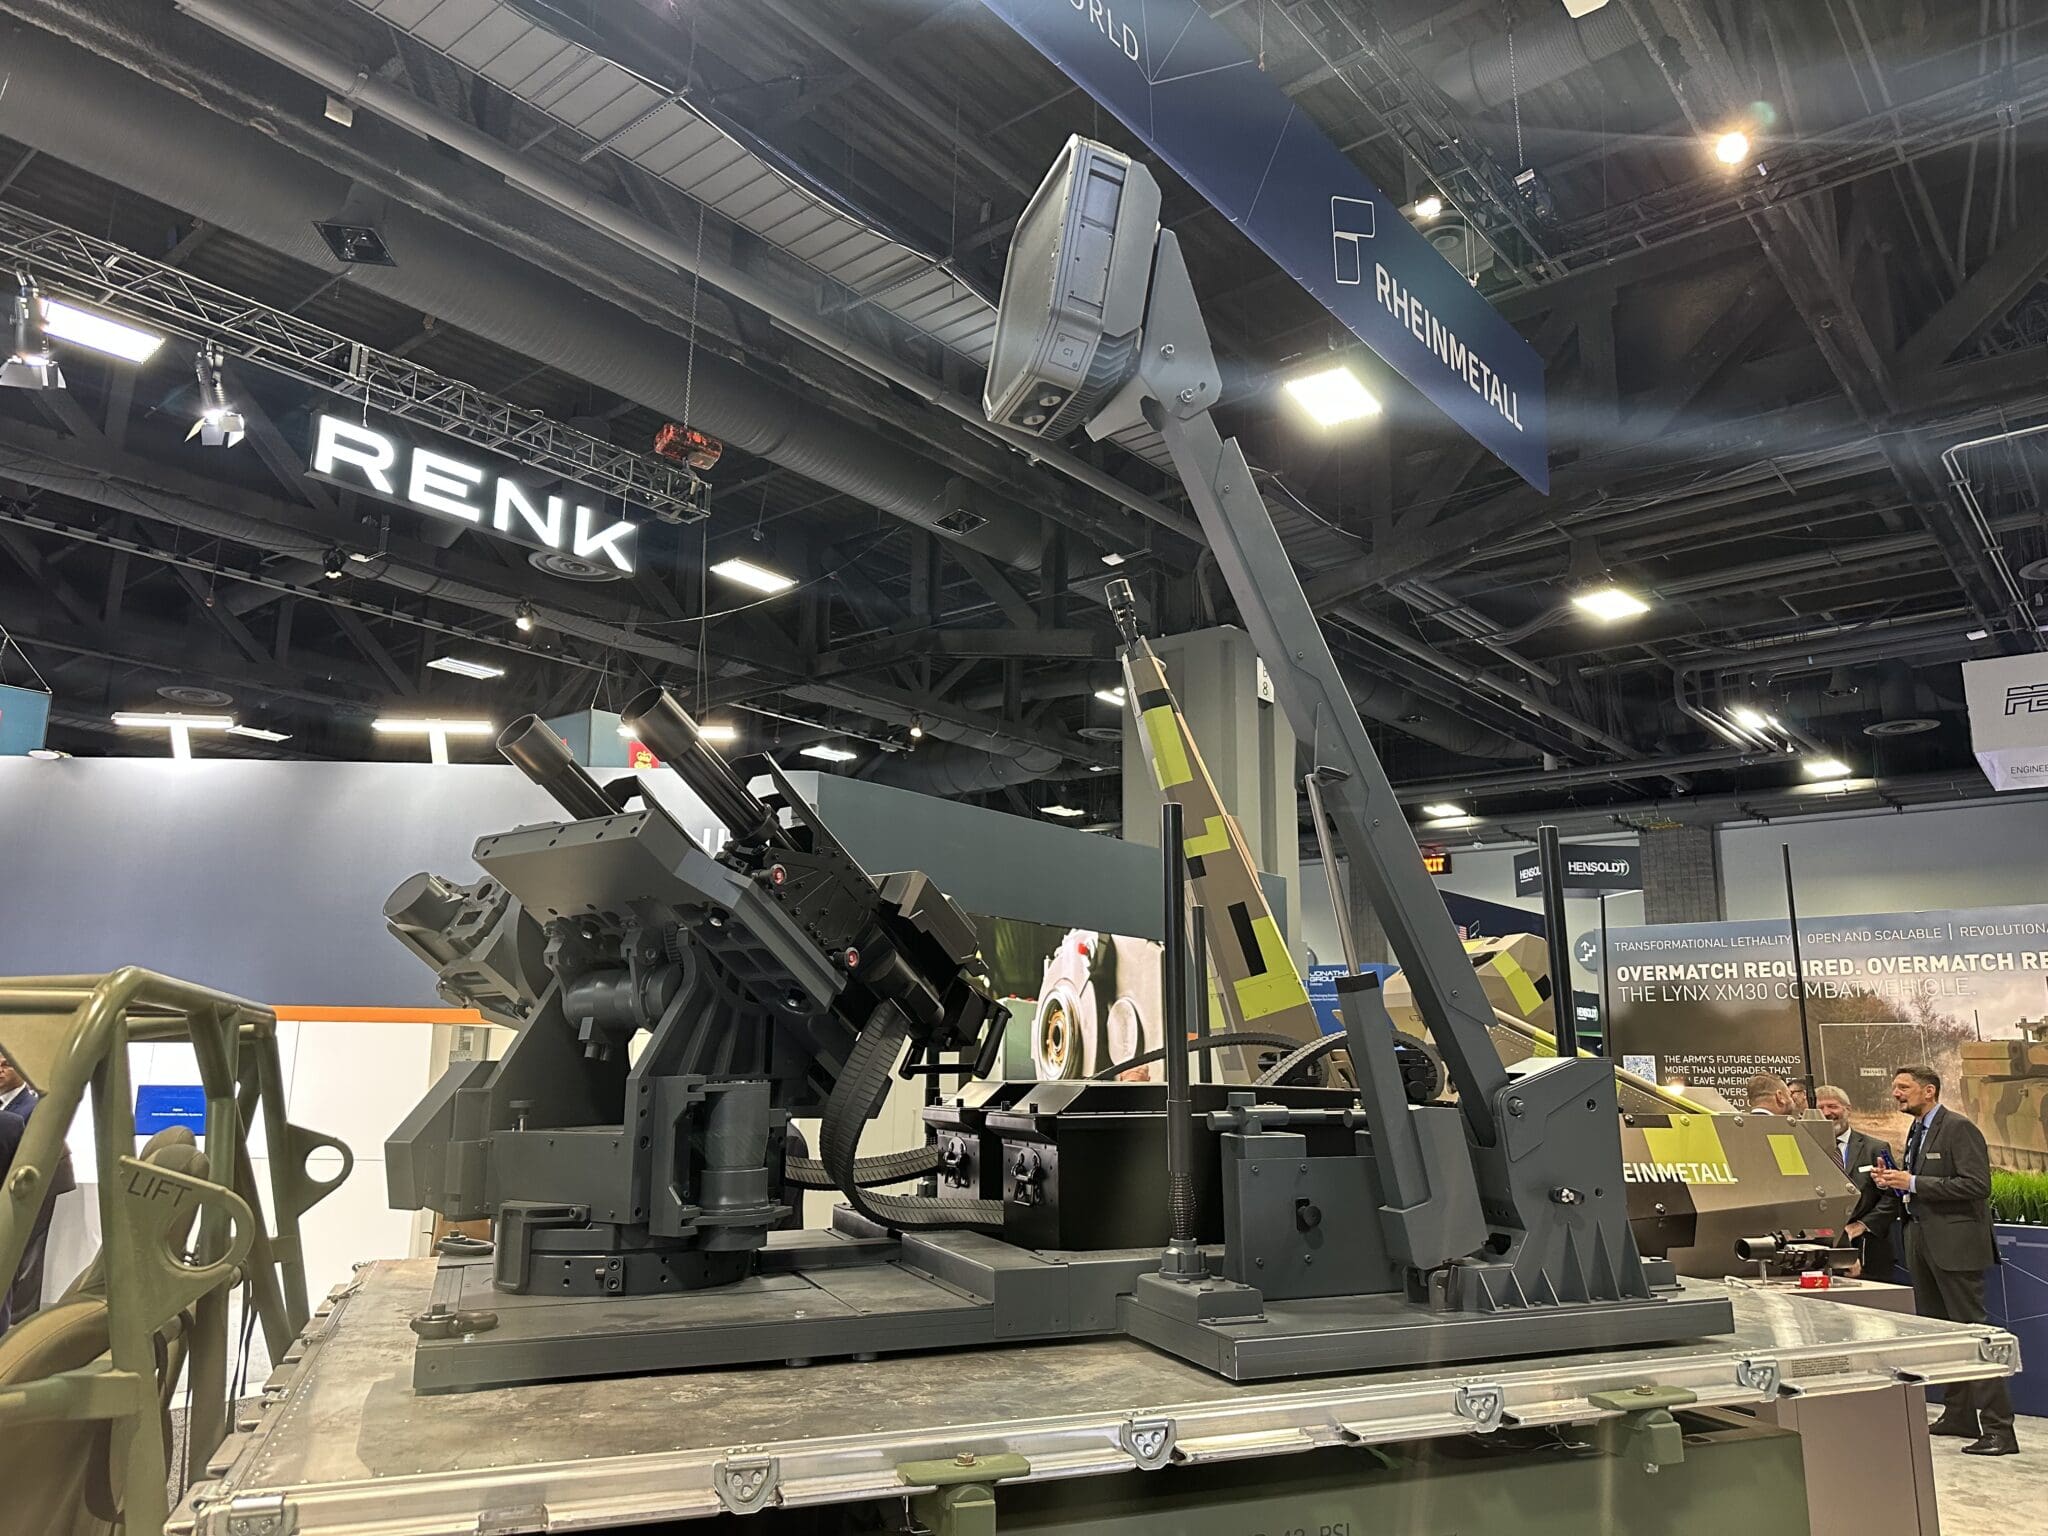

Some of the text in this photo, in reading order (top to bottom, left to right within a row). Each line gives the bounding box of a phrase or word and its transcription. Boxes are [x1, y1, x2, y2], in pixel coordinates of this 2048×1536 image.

[1070, 0, 1139, 61] RLD
[1375, 262, 1524, 432] RHEINMETALL
[315, 414, 637, 574] RENK
[1423, 858, 1445, 872] XIT
[1519, 866, 1542, 880] HENSOL
[1567, 861, 1626, 874] HENSOLDT
[1614, 938, 1728, 952] TRANSFORMATIONAL
[1731, 934, 1792, 948] LETHALITY
[1807, 932, 1841, 944] OPEN
[1844, 930, 1872, 942] AND
[1875, 927, 1942, 940] SCALABLE
[1616, 962, 1738, 982] OVERMATCH
[1743, 958, 1862, 979] REQUIRED.
[1867, 951, 2015, 975] OVERMATCH
[1618, 977, 1978, 1003] THE LYNX XM30 COMBAT VEHICLE.
[1664, 1055, 1801, 1064] THE ARMY'S FUTURE DEMANDS
[1664, 1065, 1690, 1074] MORE
[1692, 1066, 1716, 1074] THAN
[1768, 1066, 1792, 1075] THAT
[1622, 1162, 1739, 1183] EINMETALL
[127, 1171, 193, 1207] LIFT
